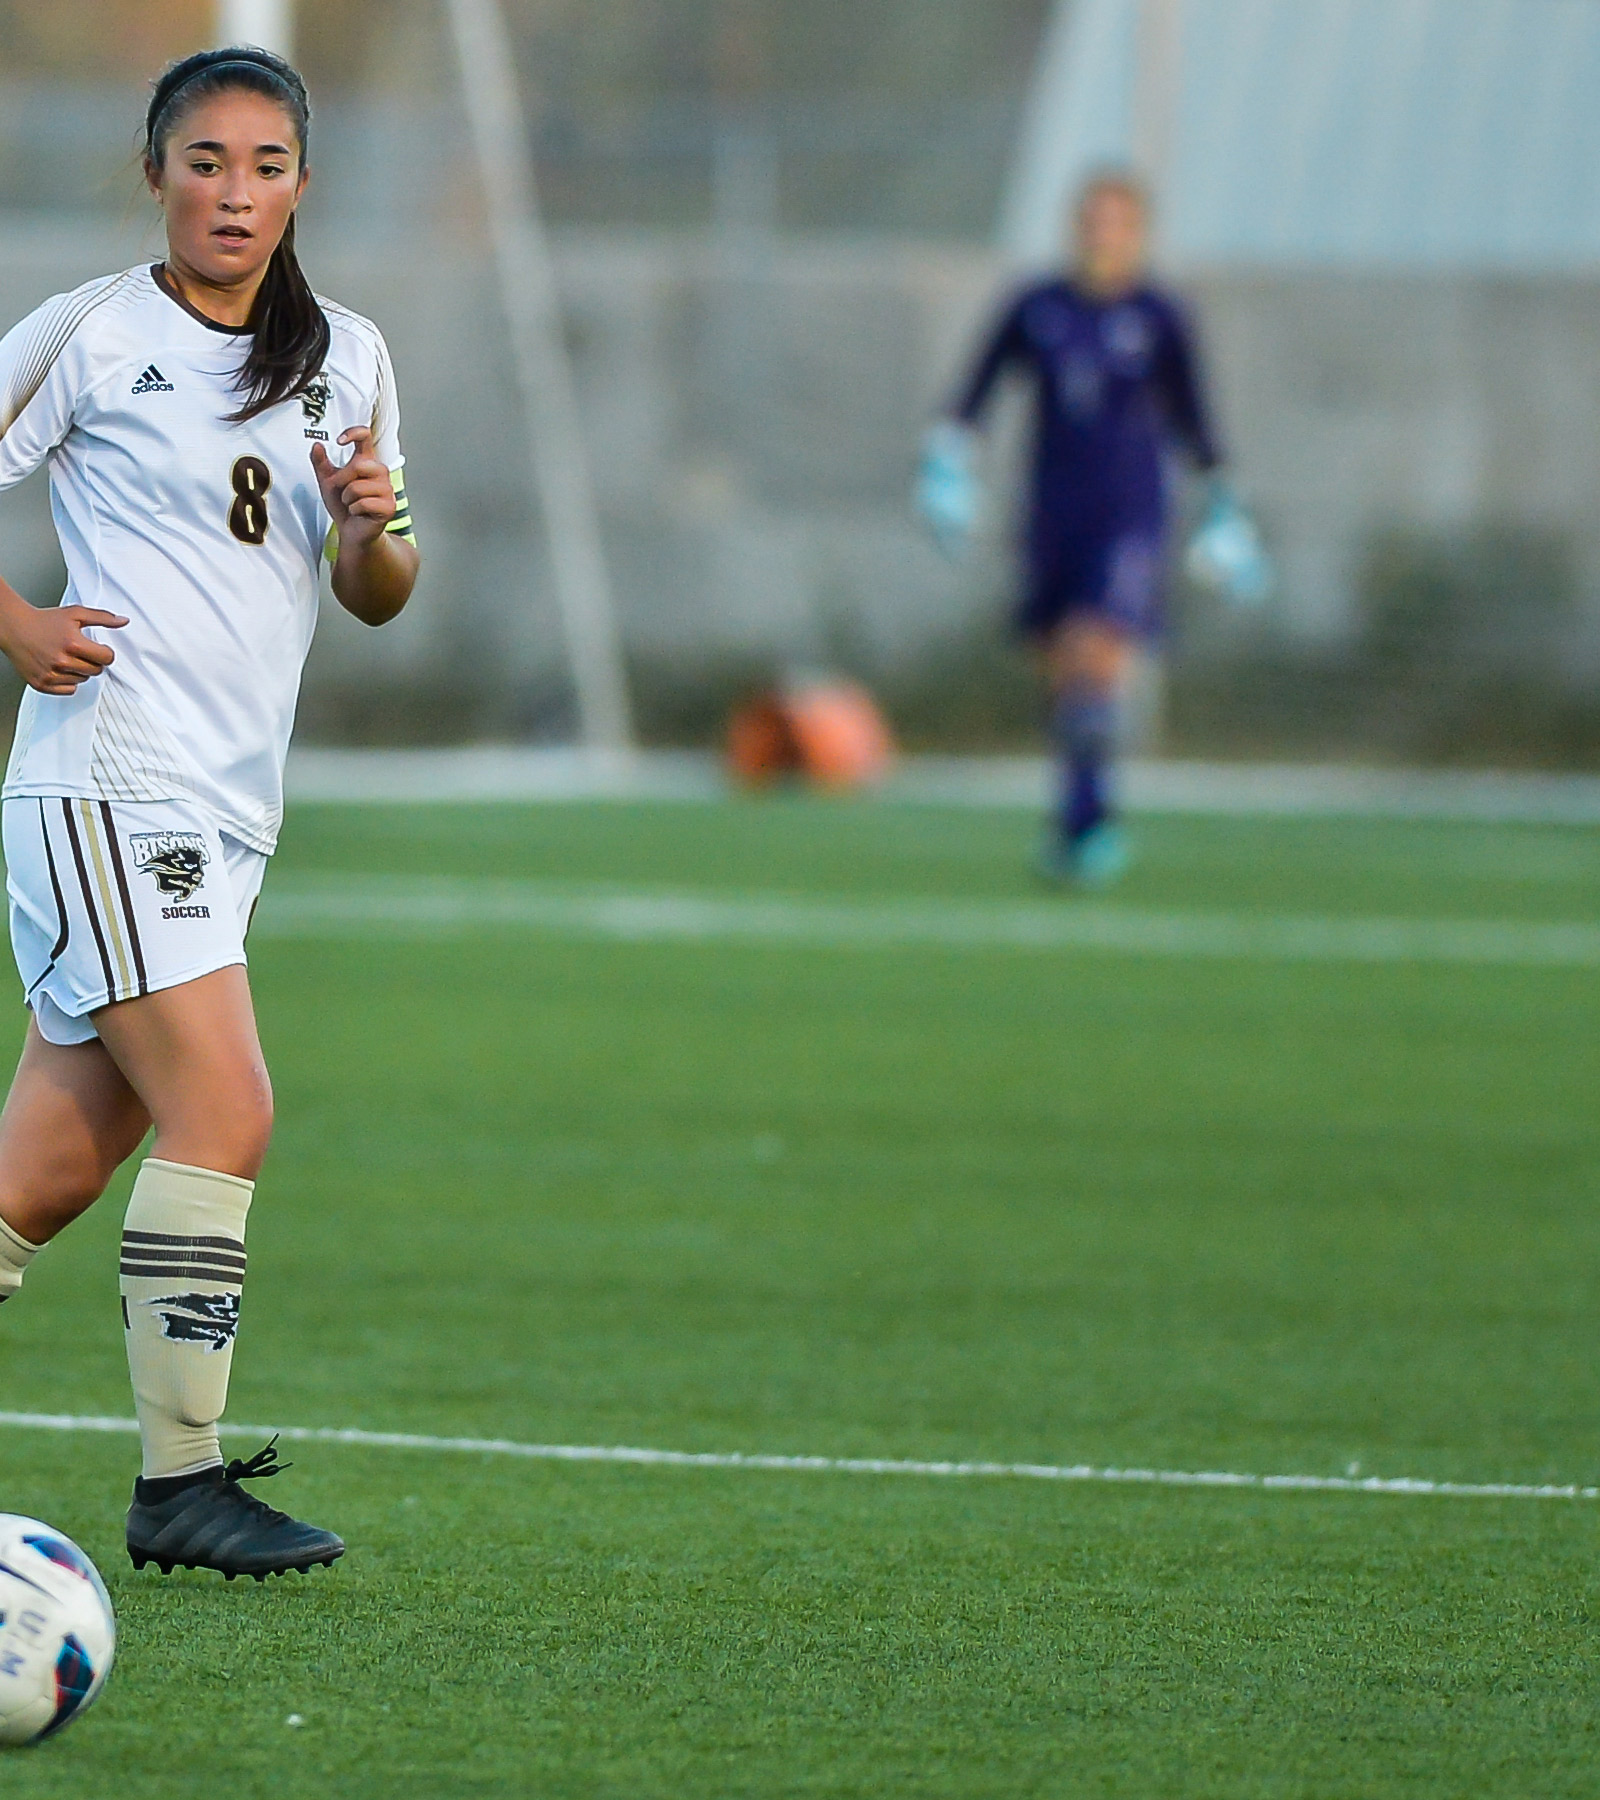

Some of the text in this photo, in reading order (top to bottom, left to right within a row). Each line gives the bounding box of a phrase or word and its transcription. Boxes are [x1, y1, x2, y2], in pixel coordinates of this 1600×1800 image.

[131, 381, 175, 394] adidas
[227, 453, 272, 547] 8
[129, 835, 212, 867] BISONS
[161, 905, 211, 919] SOCCER
